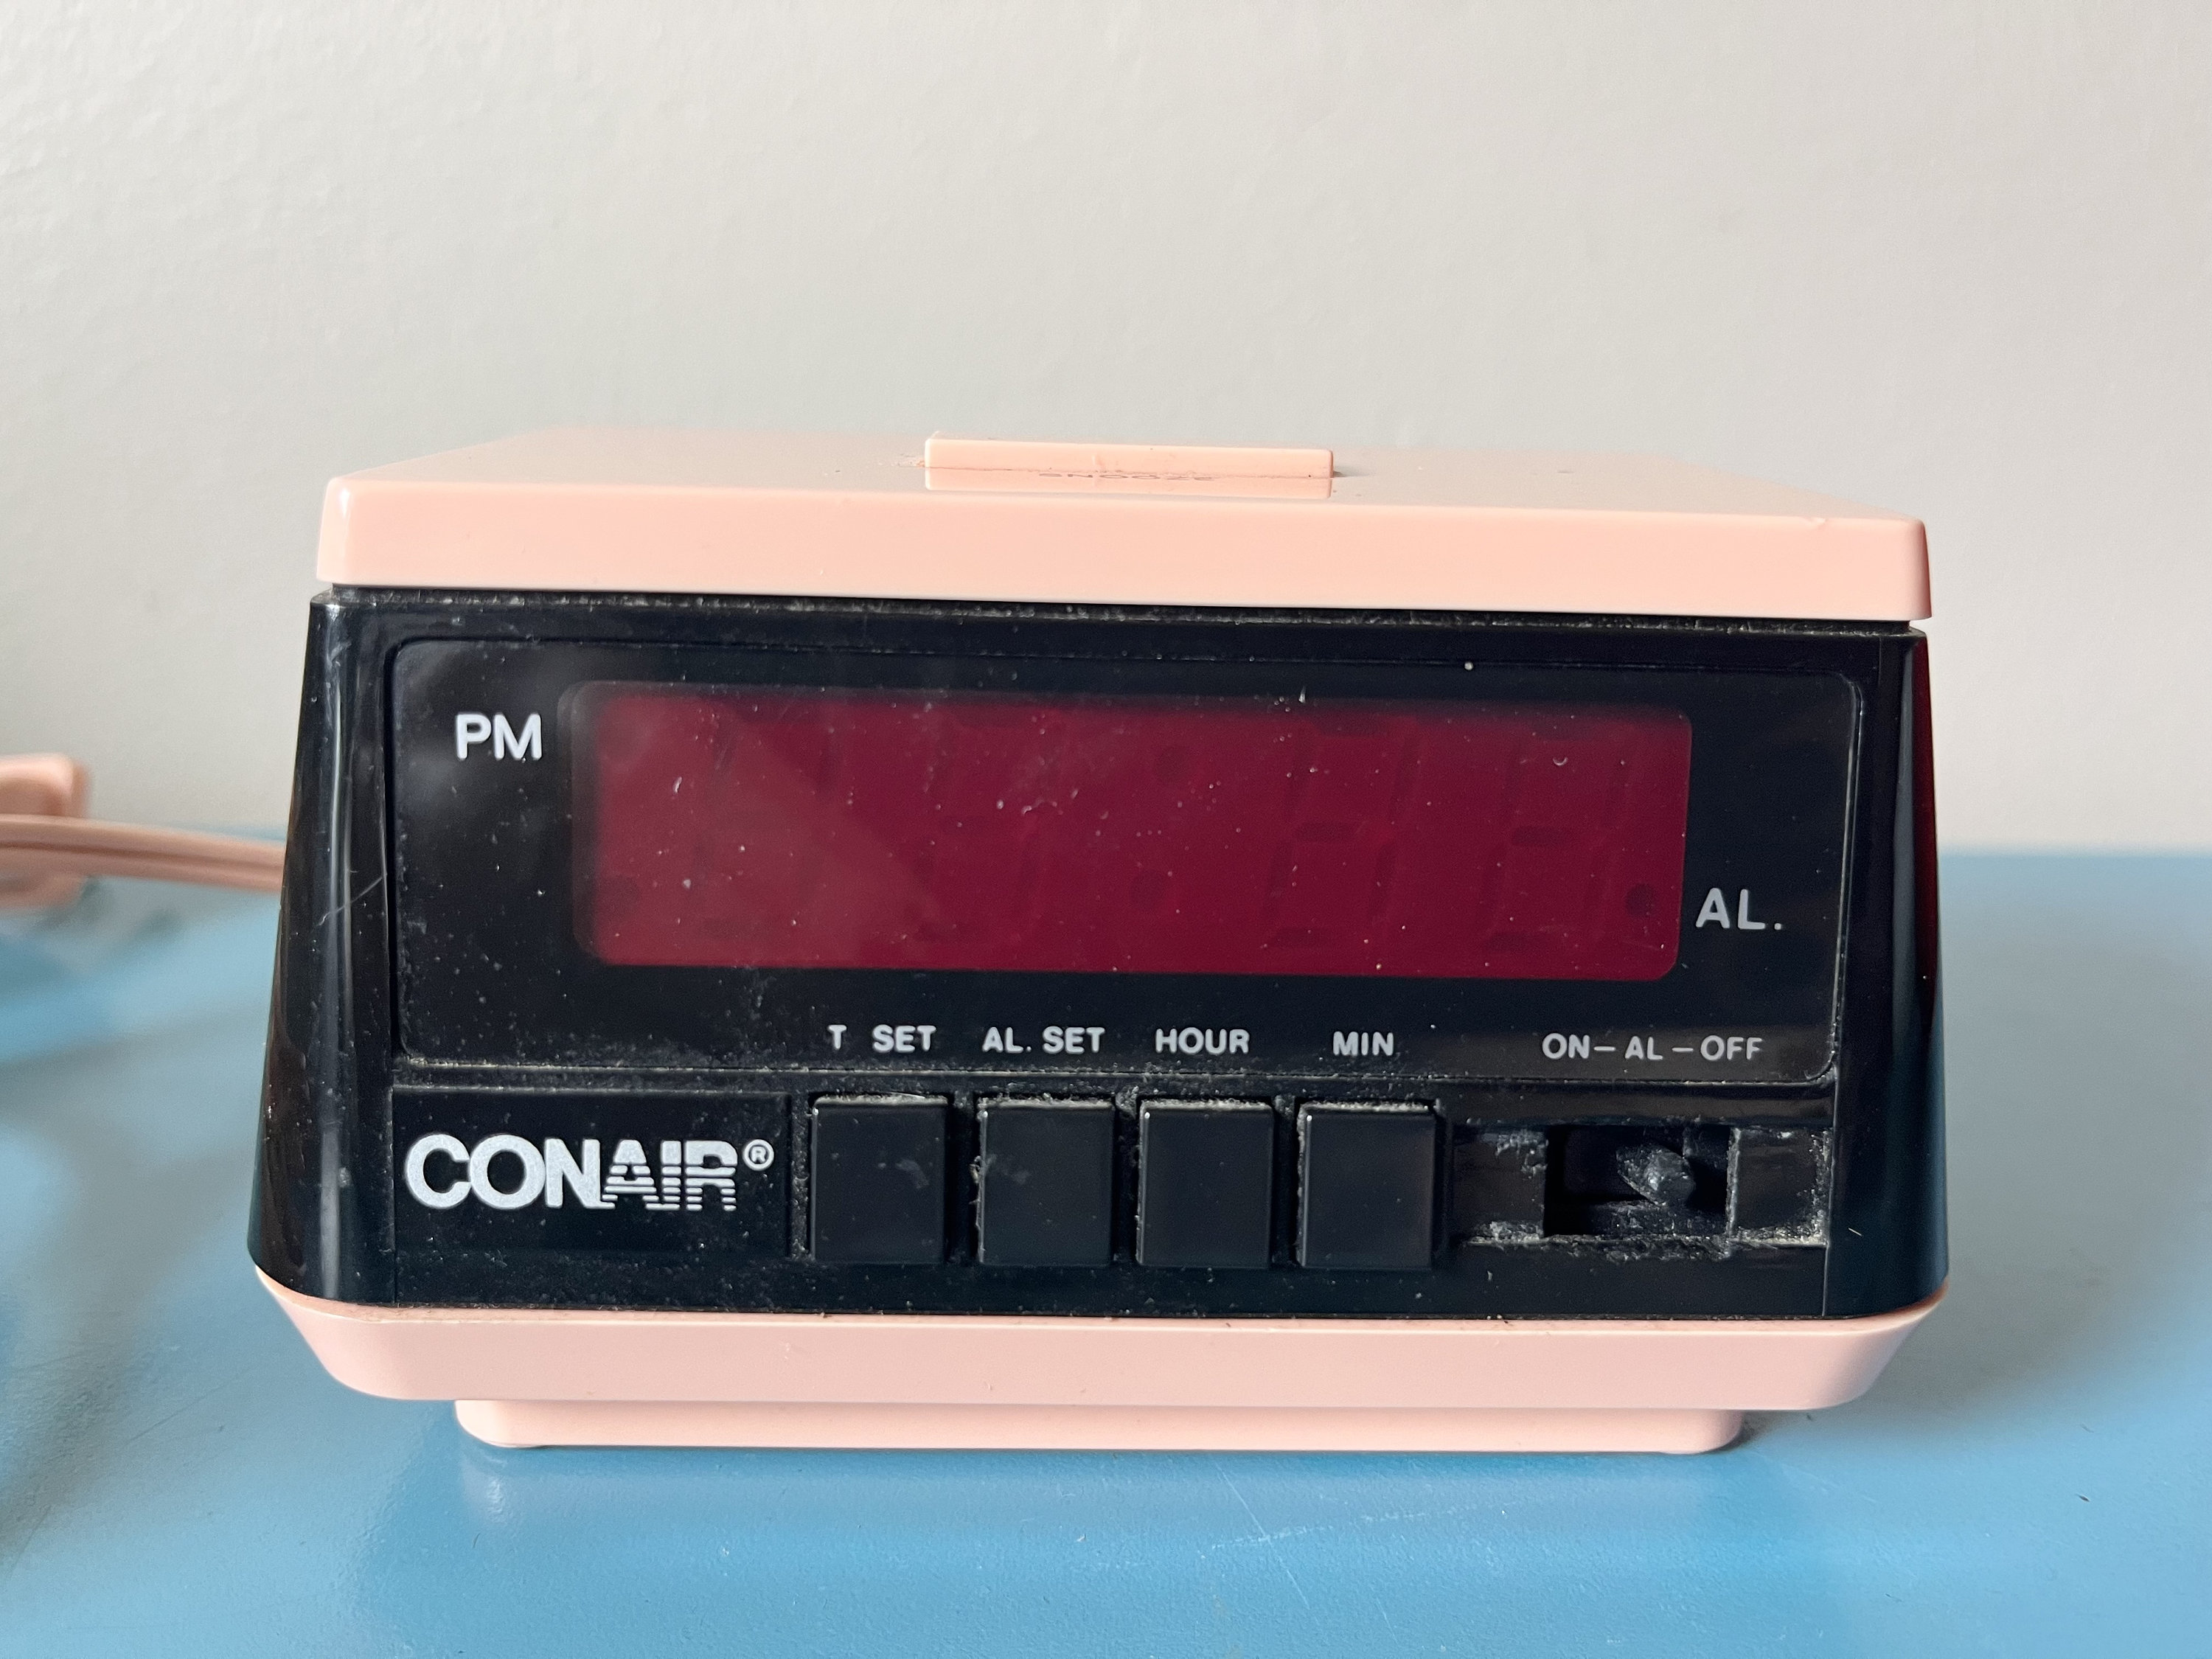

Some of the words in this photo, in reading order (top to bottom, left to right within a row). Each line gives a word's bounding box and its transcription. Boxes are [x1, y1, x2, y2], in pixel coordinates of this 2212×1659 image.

[455, 712, 543, 760] PM
[1695, 887, 1783, 931] AL.
[827, 1023, 848, 1051] T
[872, 1023, 937, 1053] SET
[981, 1026, 1032, 1054] AL.
[1042, 1025, 1106, 1054] SET
[1155, 1026, 1251, 1056] HOUR
[1332, 1031, 1395, 1057] MIN
